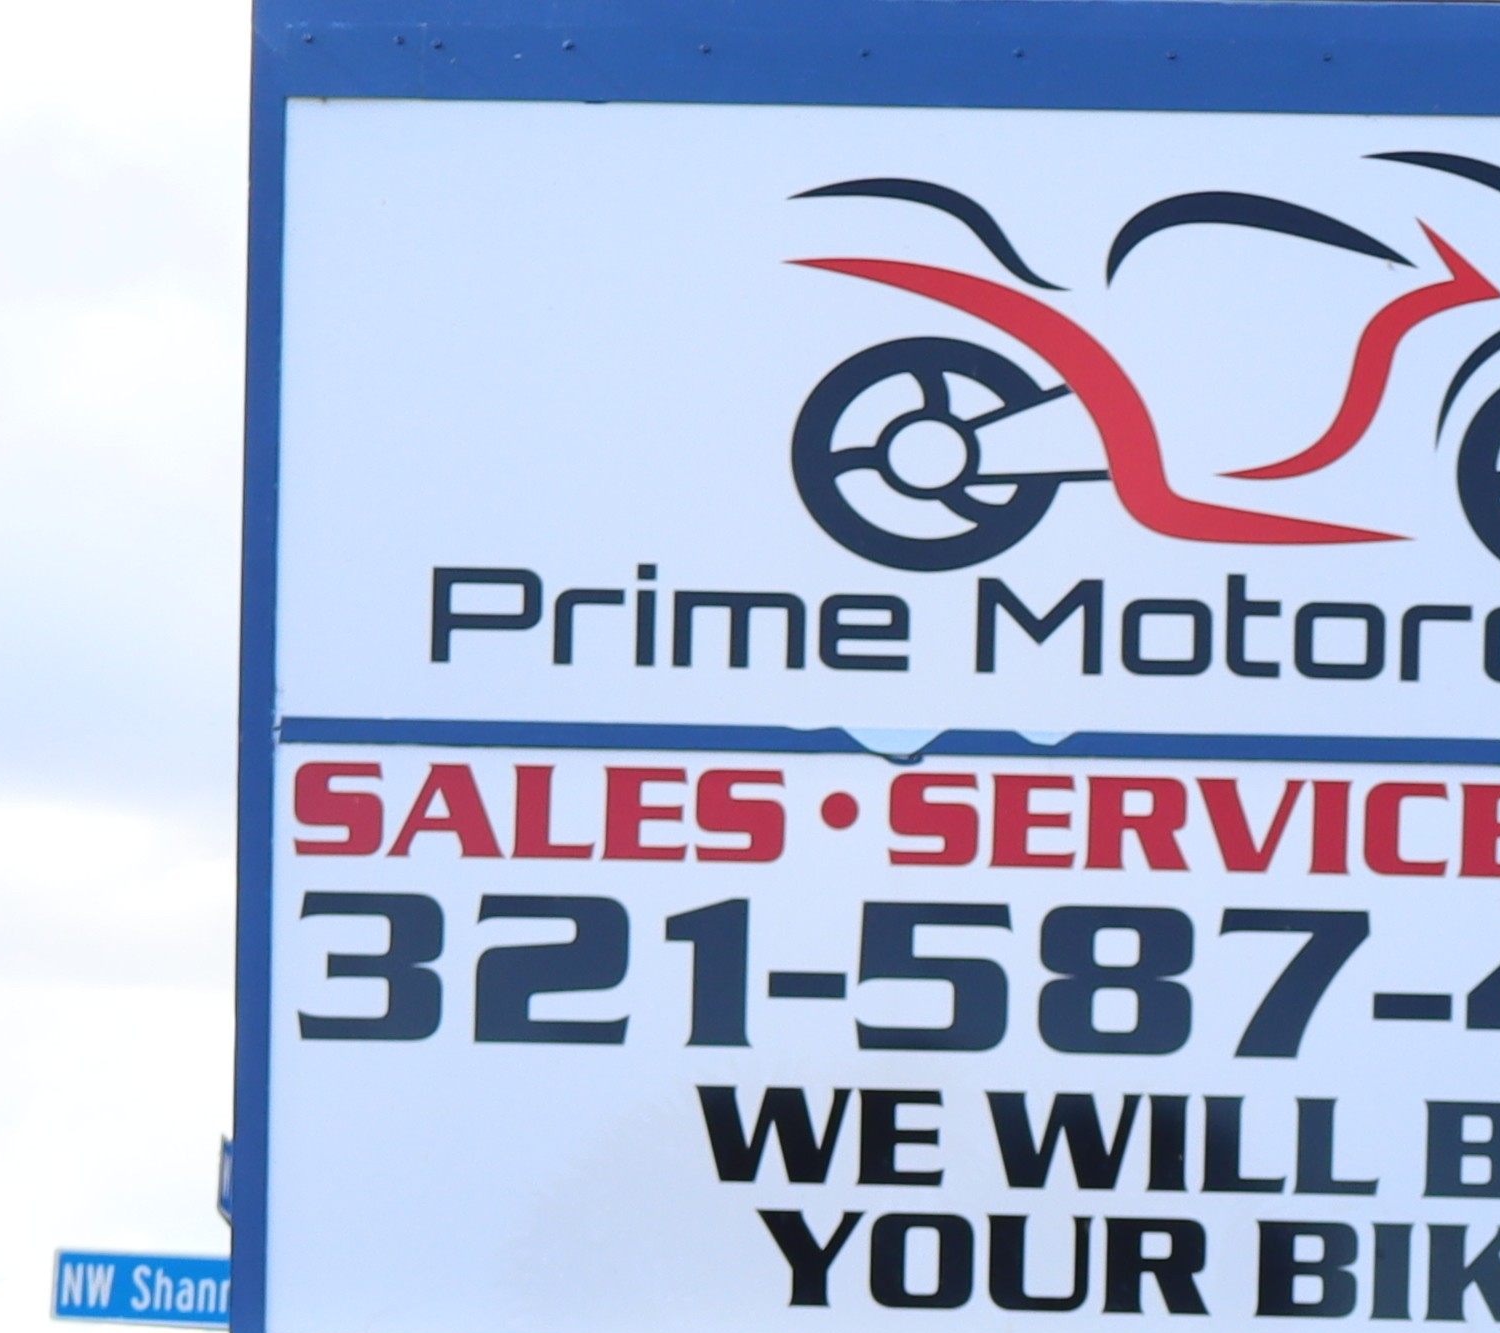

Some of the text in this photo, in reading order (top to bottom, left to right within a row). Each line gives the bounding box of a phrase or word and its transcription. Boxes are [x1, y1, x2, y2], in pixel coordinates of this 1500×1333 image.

[433, 566, 909, 670] Prime
[293, 760, 786, 863] SALES
[700, 1086, 942, 1188] WE
[987, 1091, 1379, 1197] WILL
[61, 1263, 114, 1309] NW
[761, 1209, 1209, 1318] YOUR
